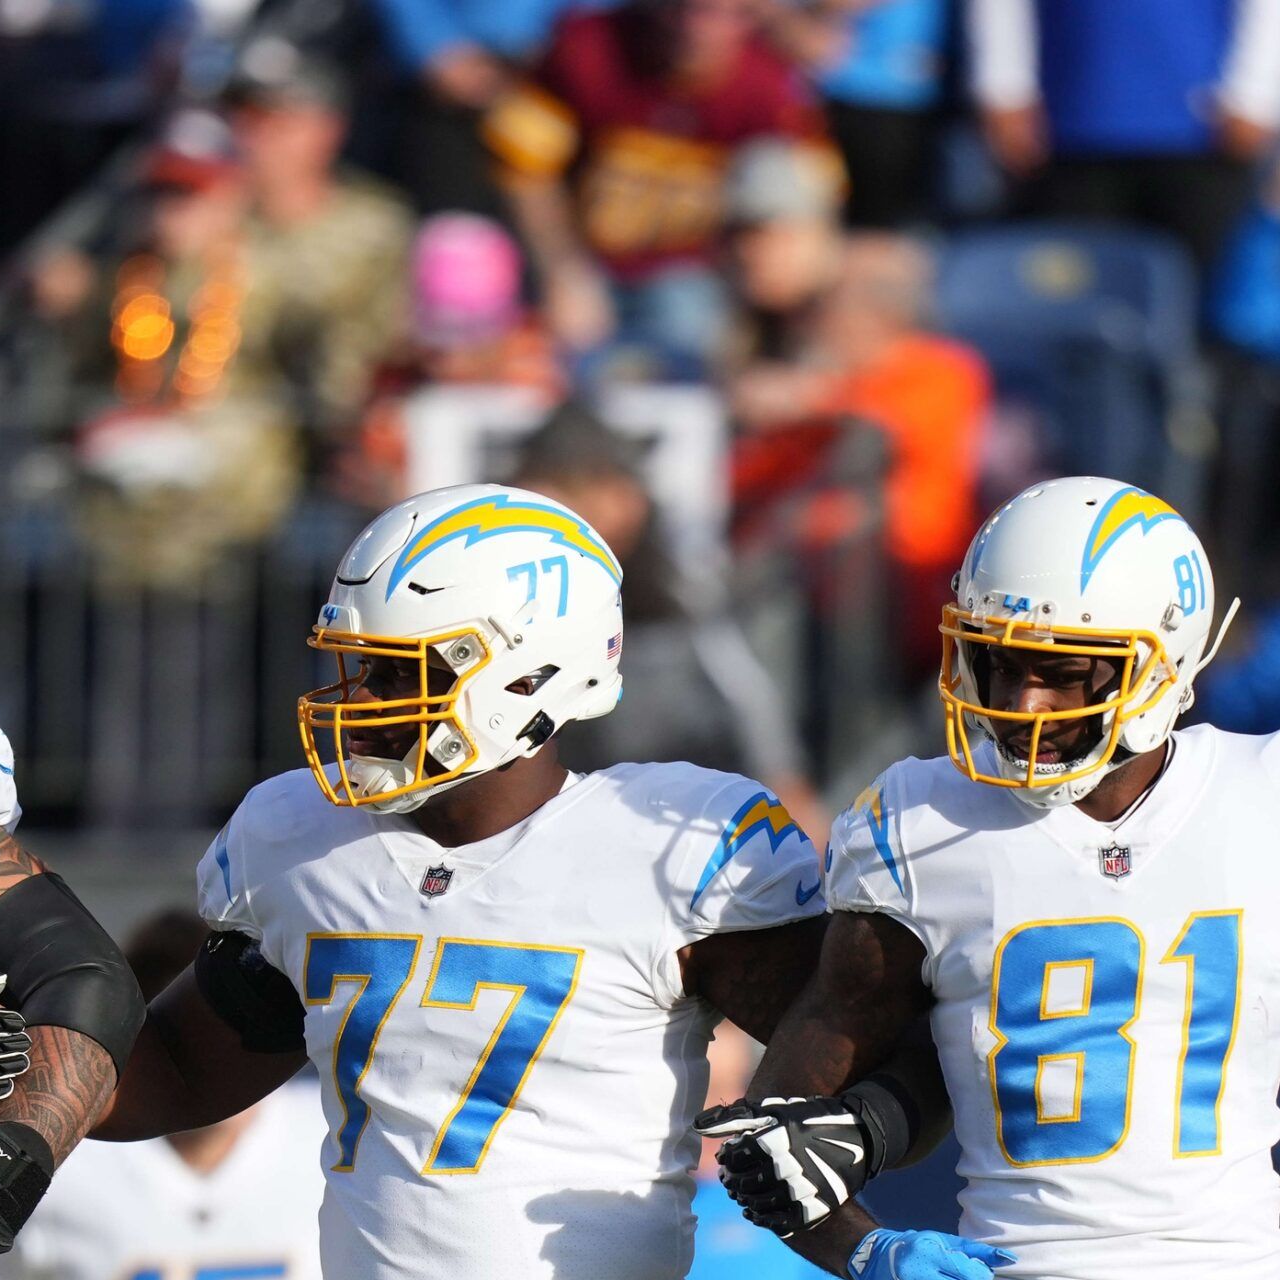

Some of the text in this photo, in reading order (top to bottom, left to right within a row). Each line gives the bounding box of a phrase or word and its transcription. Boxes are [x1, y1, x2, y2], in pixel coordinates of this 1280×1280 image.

[505, 554, 570, 625] 77
[1173, 549, 1206, 618] 81
[1104, 857, 1129, 875] NFL
[303, 926, 586, 1176] 77
[986, 907, 1245, 1169] 81
